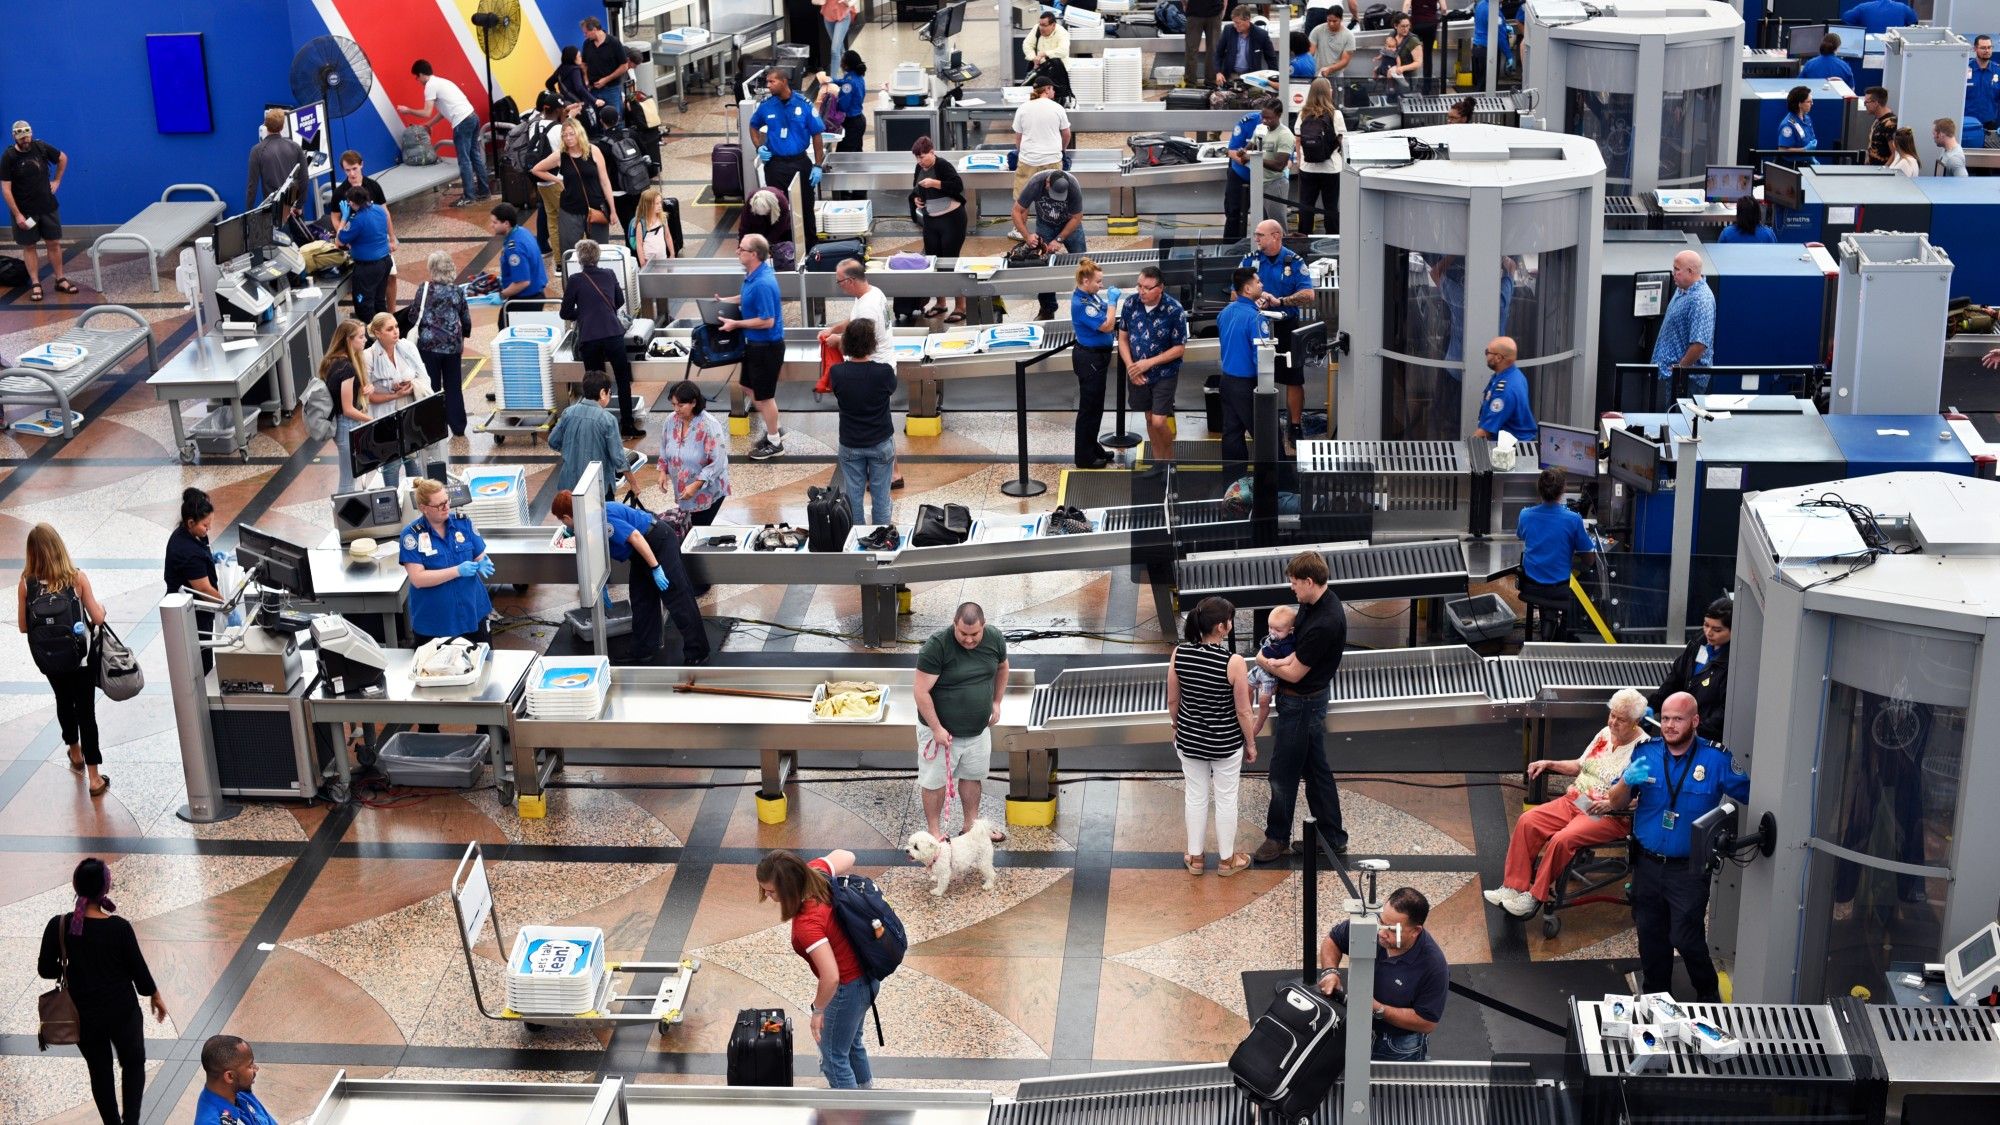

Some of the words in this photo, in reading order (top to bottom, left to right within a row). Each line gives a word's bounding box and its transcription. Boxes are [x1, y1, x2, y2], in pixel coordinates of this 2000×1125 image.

[299, 118, 315, 128] FORGET
[540, 944, 553, 956] talk
[545, 946, 570, 974] lean!
